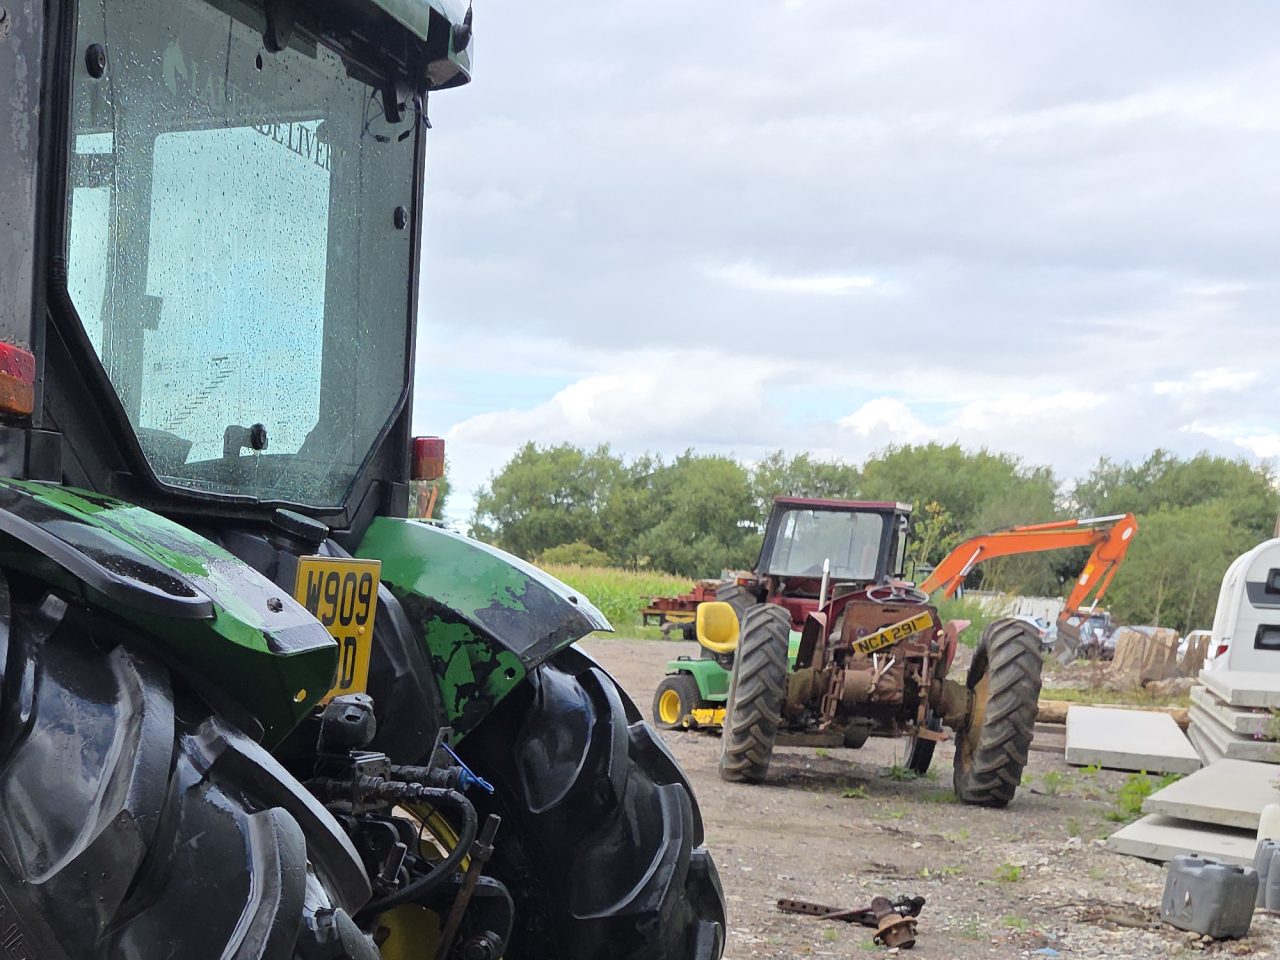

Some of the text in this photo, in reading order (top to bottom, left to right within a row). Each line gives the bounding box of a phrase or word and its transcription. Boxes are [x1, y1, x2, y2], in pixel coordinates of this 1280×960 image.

[306, 571, 372, 626] W909
[858, 620, 918, 653] NCA 291
